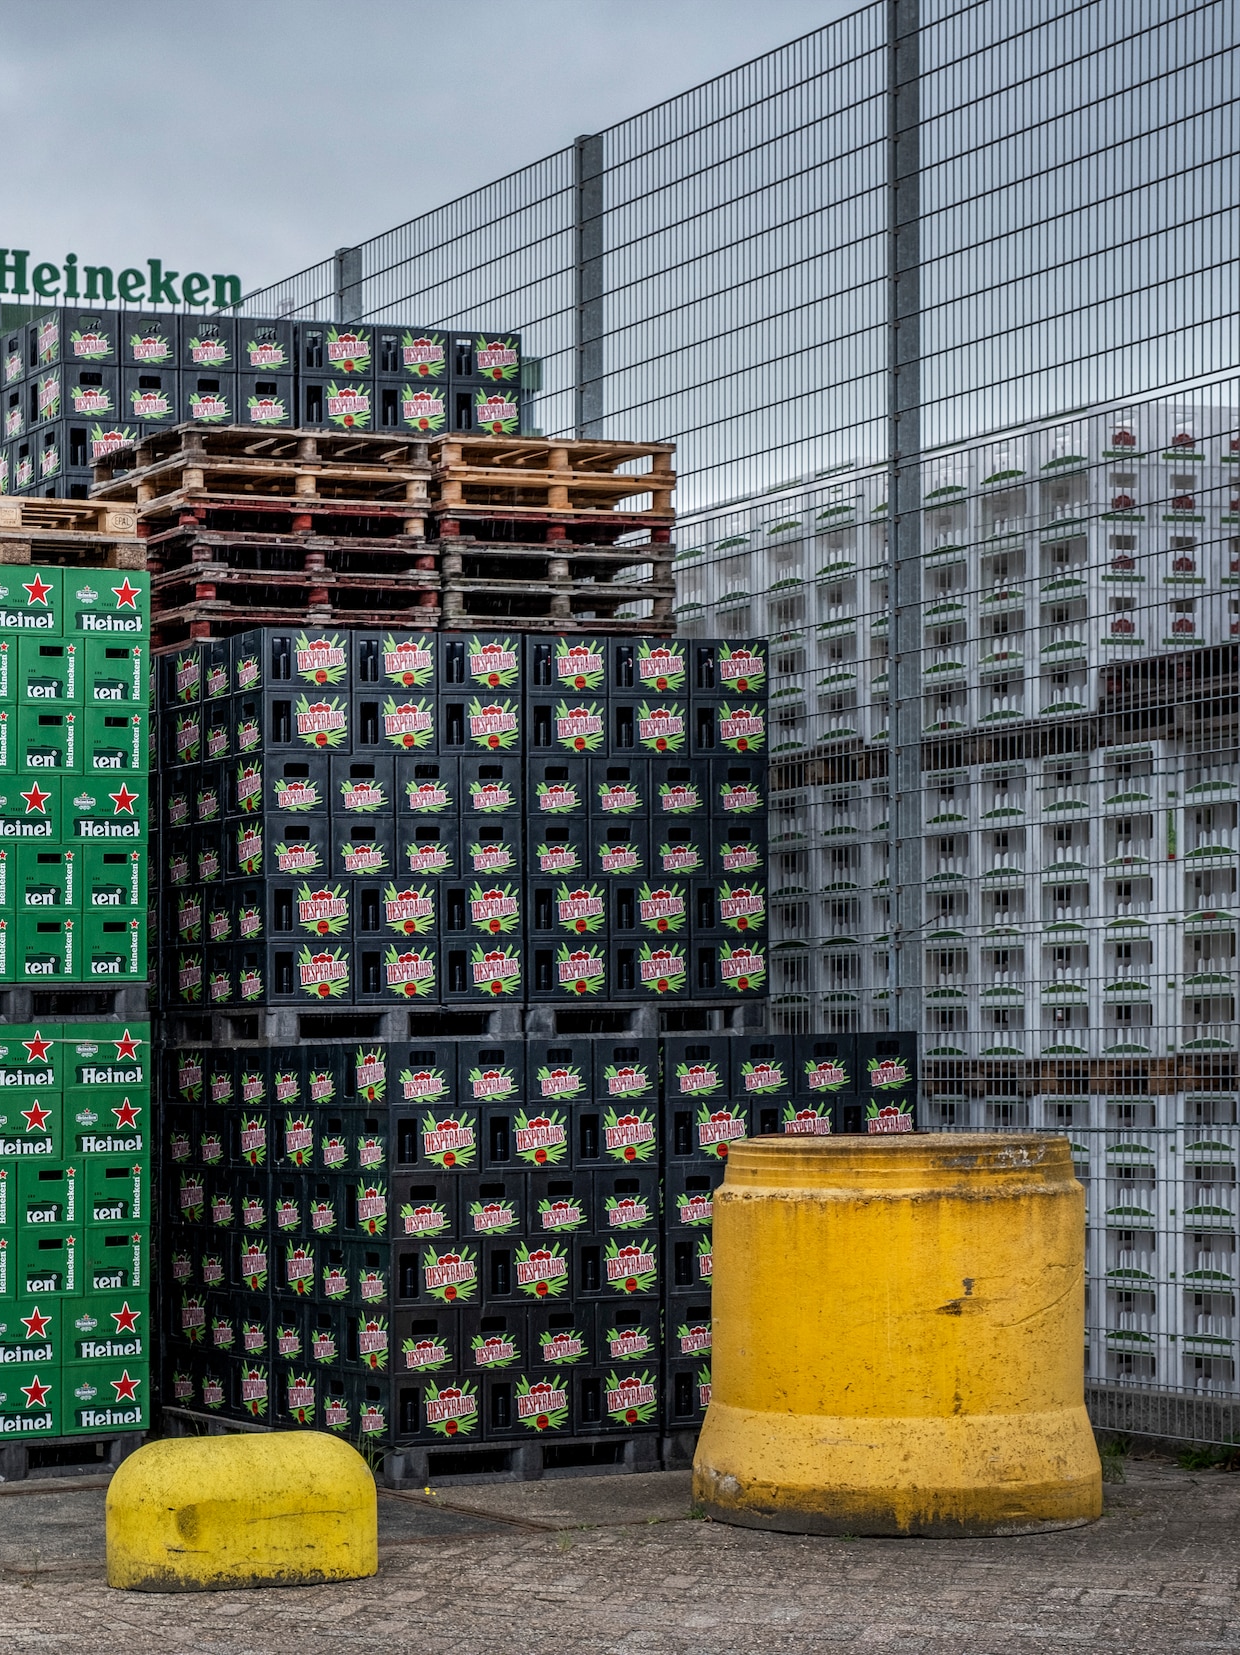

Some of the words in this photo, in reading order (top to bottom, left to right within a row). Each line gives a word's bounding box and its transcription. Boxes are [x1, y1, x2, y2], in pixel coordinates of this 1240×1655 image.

[329, 342, 368, 360] DESPERADOS
[404, 346, 443, 364] DESPERADOS
[329, 396, 368, 415] DESPERADOS
[404, 400, 443, 418] DESPERADOS
[298, 649, 343, 670] DESPERADOS
[385, 651, 430, 672] DESPERADOS
[471, 653, 515, 673] DESPERADOS
[558, 655, 601, 676] DESPERADOS
[640, 657, 682, 677] DESPERADOS
[721, 658, 762, 679] DESPERADOS
[67, 657, 76, 699] Heineken
[298, 712, 343, 733] DESPERADOS
[386, 713, 430, 734] DESPERADOS
[471, 714, 515, 735] DESPERADOS
[558, 717, 601, 737] DESPERADOS
[640, 717, 682, 738] DESPERADOS
[721, 718, 762, 738] DESPERADOS
[66, 726, 76, 767] Heineken
[65, 864, 75, 905] Heineken
[300, 900, 345, 920] DESPERADOS
[387, 899, 431, 920] DESPERADOS
[473, 899, 515, 919] DESPERADOS
[559, 899, 602, 919] DESPERADOS
[642, 898, 682, 919] DESPERADOS
[722, 897, 762, 917] DESPERADOS
[65, 933, 74, 974] Heineken
[425, 1130, 472, 1152] DESPERADOS
[517, 1127, 563, 1149] DESPERADOS
[606, 1125, 652, 1147] DESPERADOS
[699, 1121, 744, 1143] DESPERADOS
[67, 1180, 76, 1221] Heineken
[132, 1246, 142, 1287] Heineken
[426, 1262, 474, 1286] DESPERADOS
[518, 1260, 564, 1282] DESPERADOS
[608, 1255, 654, 1278] DESPERADOS
[427, 1396, 475, 1421] DESPERADOS
[518, 1391, 565, 1416] DESPERADOS
[608, 1386, 654, 1411] DESPERADOS
